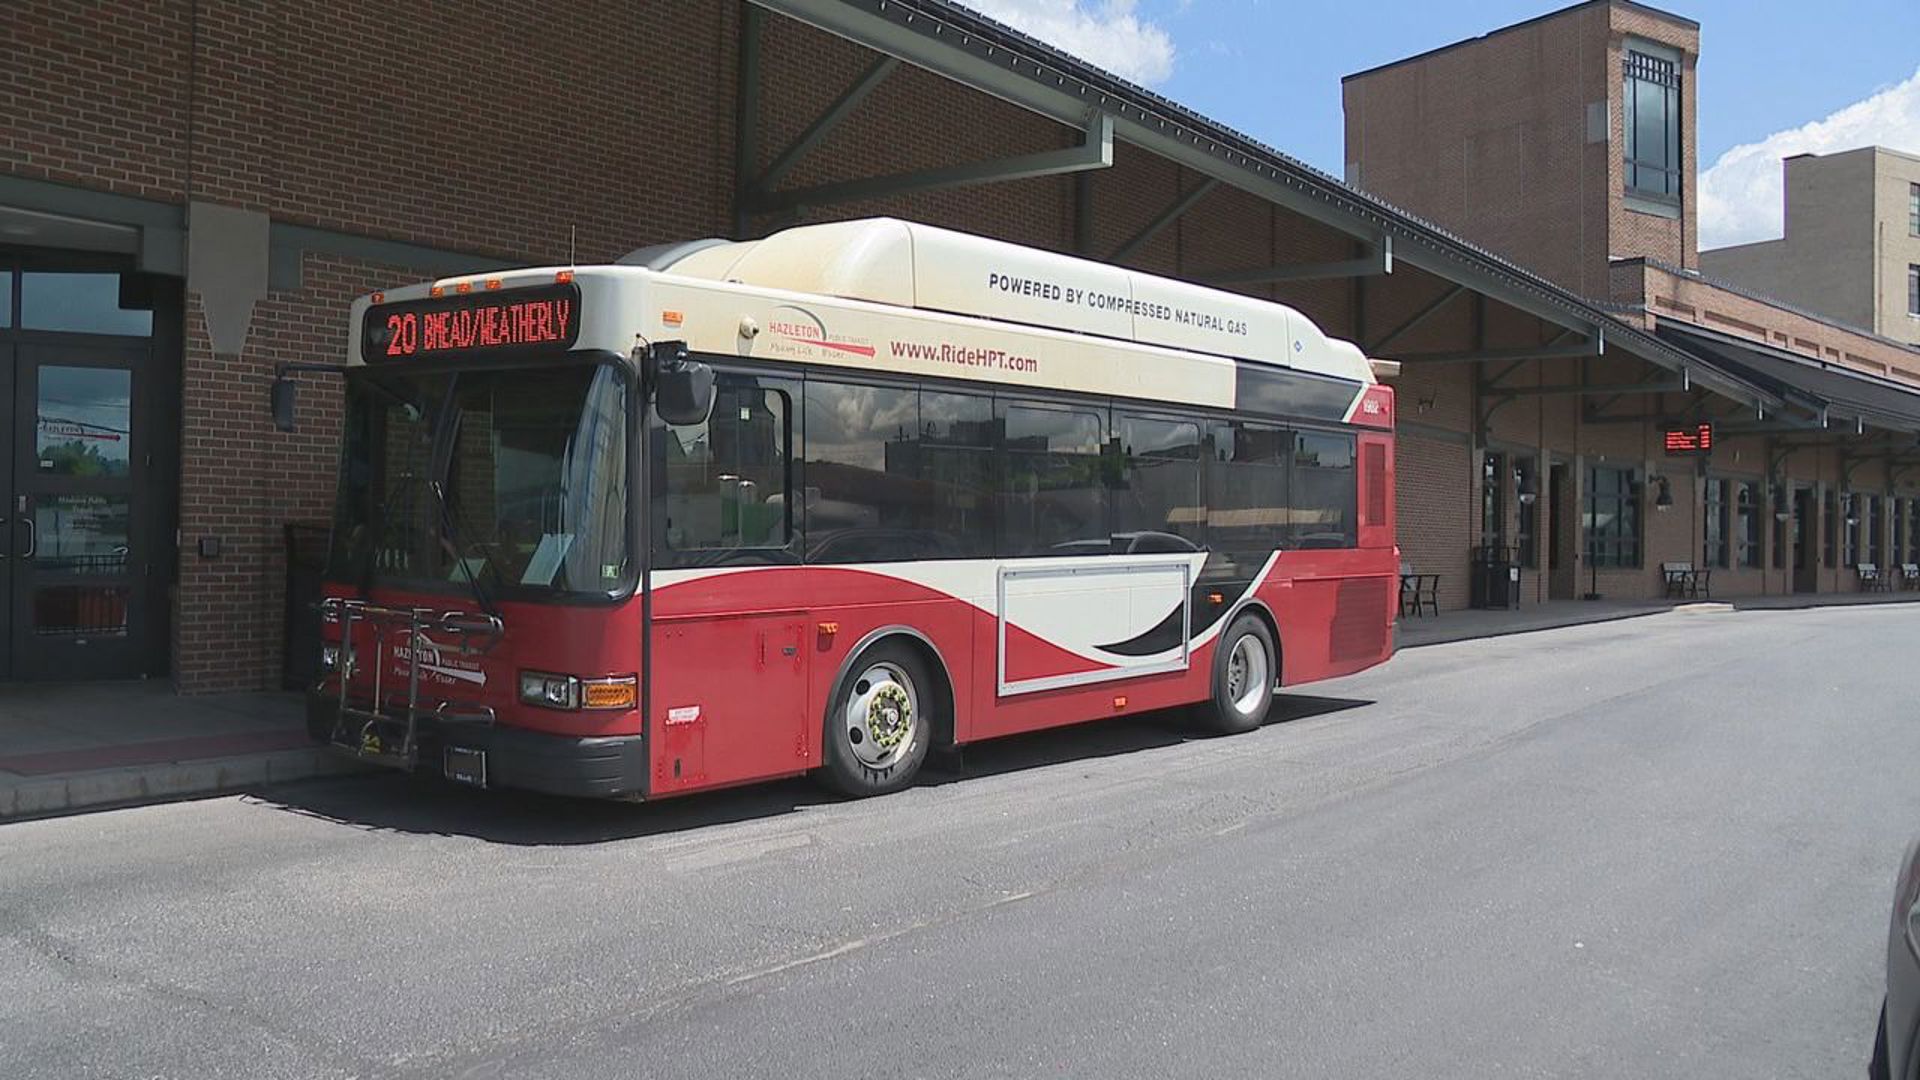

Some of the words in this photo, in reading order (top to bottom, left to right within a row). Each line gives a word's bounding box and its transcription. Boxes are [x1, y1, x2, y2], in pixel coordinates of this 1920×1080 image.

[989, 273, 1061, 301] POWERED
[1066, 287, 1084, 305] BY
[1087, 292, 1171, 320] COMPRESSED
[1175, 308, 1225, 332] NATURAL
[1227, 319, 1248, 336] GAS
[386, 313, 418, 356] 20
[769, 321, 820, 339] HAZLETON
[890, 340, 1038, 373] www.RideHPT.com
